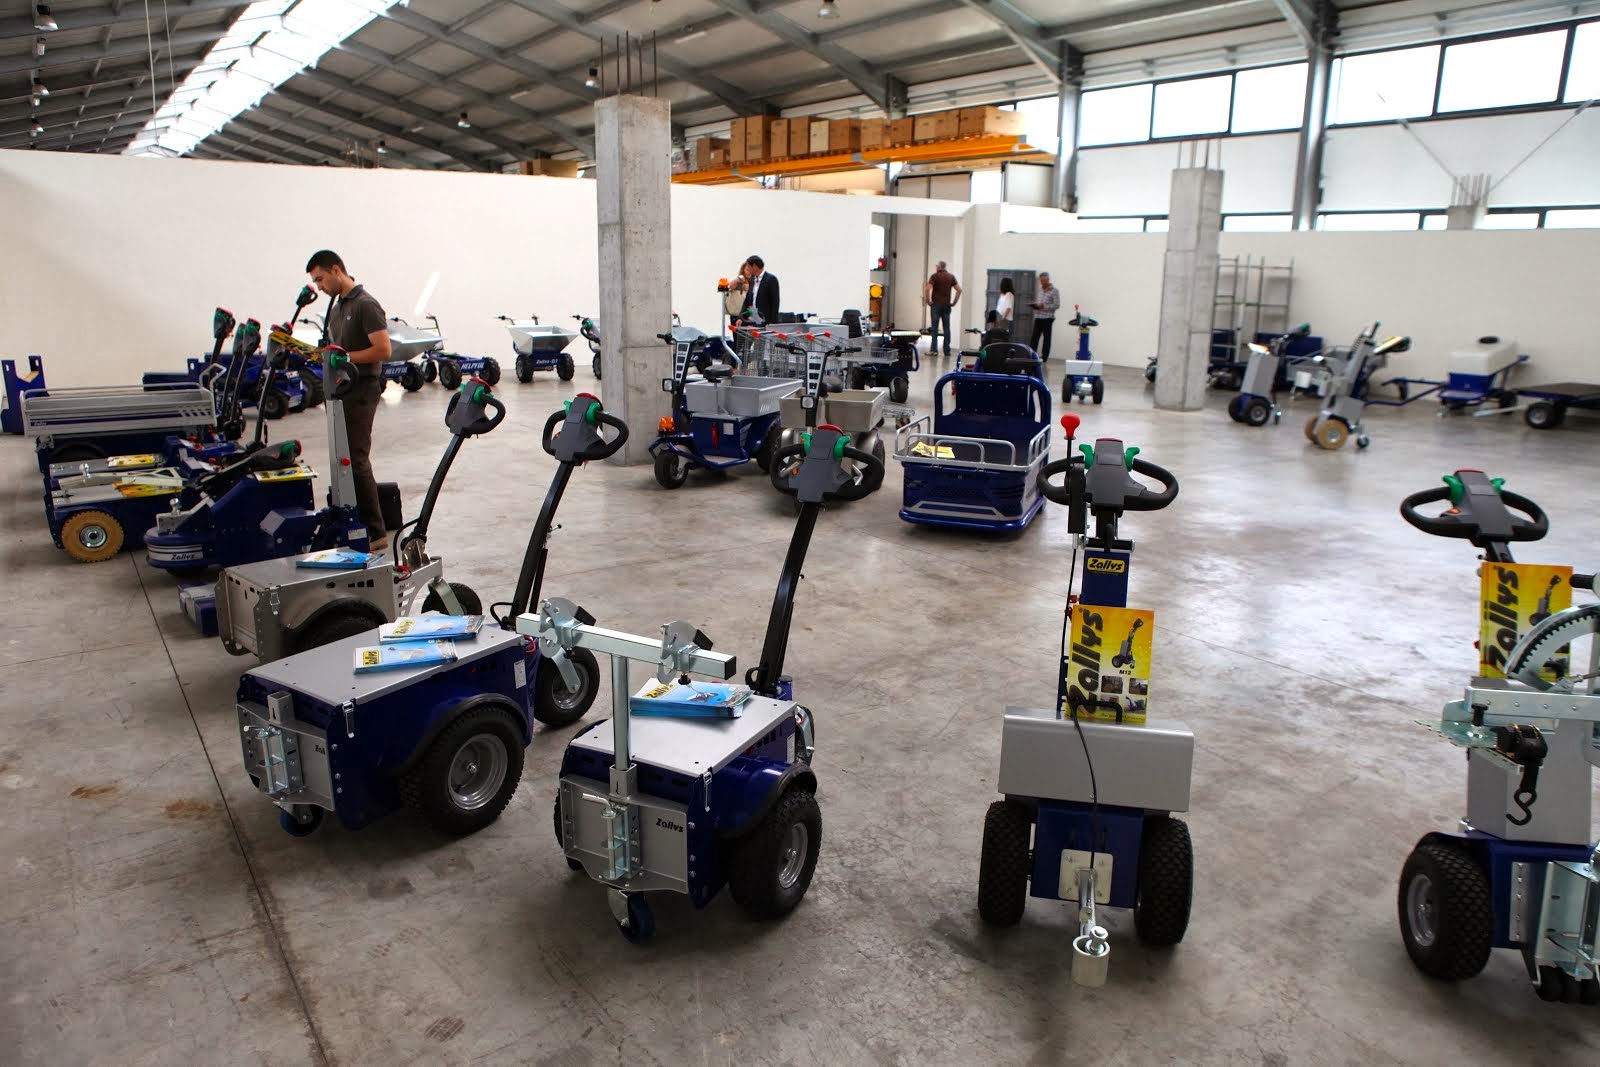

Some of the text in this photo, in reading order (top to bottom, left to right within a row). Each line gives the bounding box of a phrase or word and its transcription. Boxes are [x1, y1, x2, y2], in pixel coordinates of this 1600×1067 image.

[461, 362, 485, 370] HELPFUL
[1089, 558, 1122, 571] Zallys
[1068, 608, 1104, 714] Zallys
[656, 818, 684, 832] Zallys
